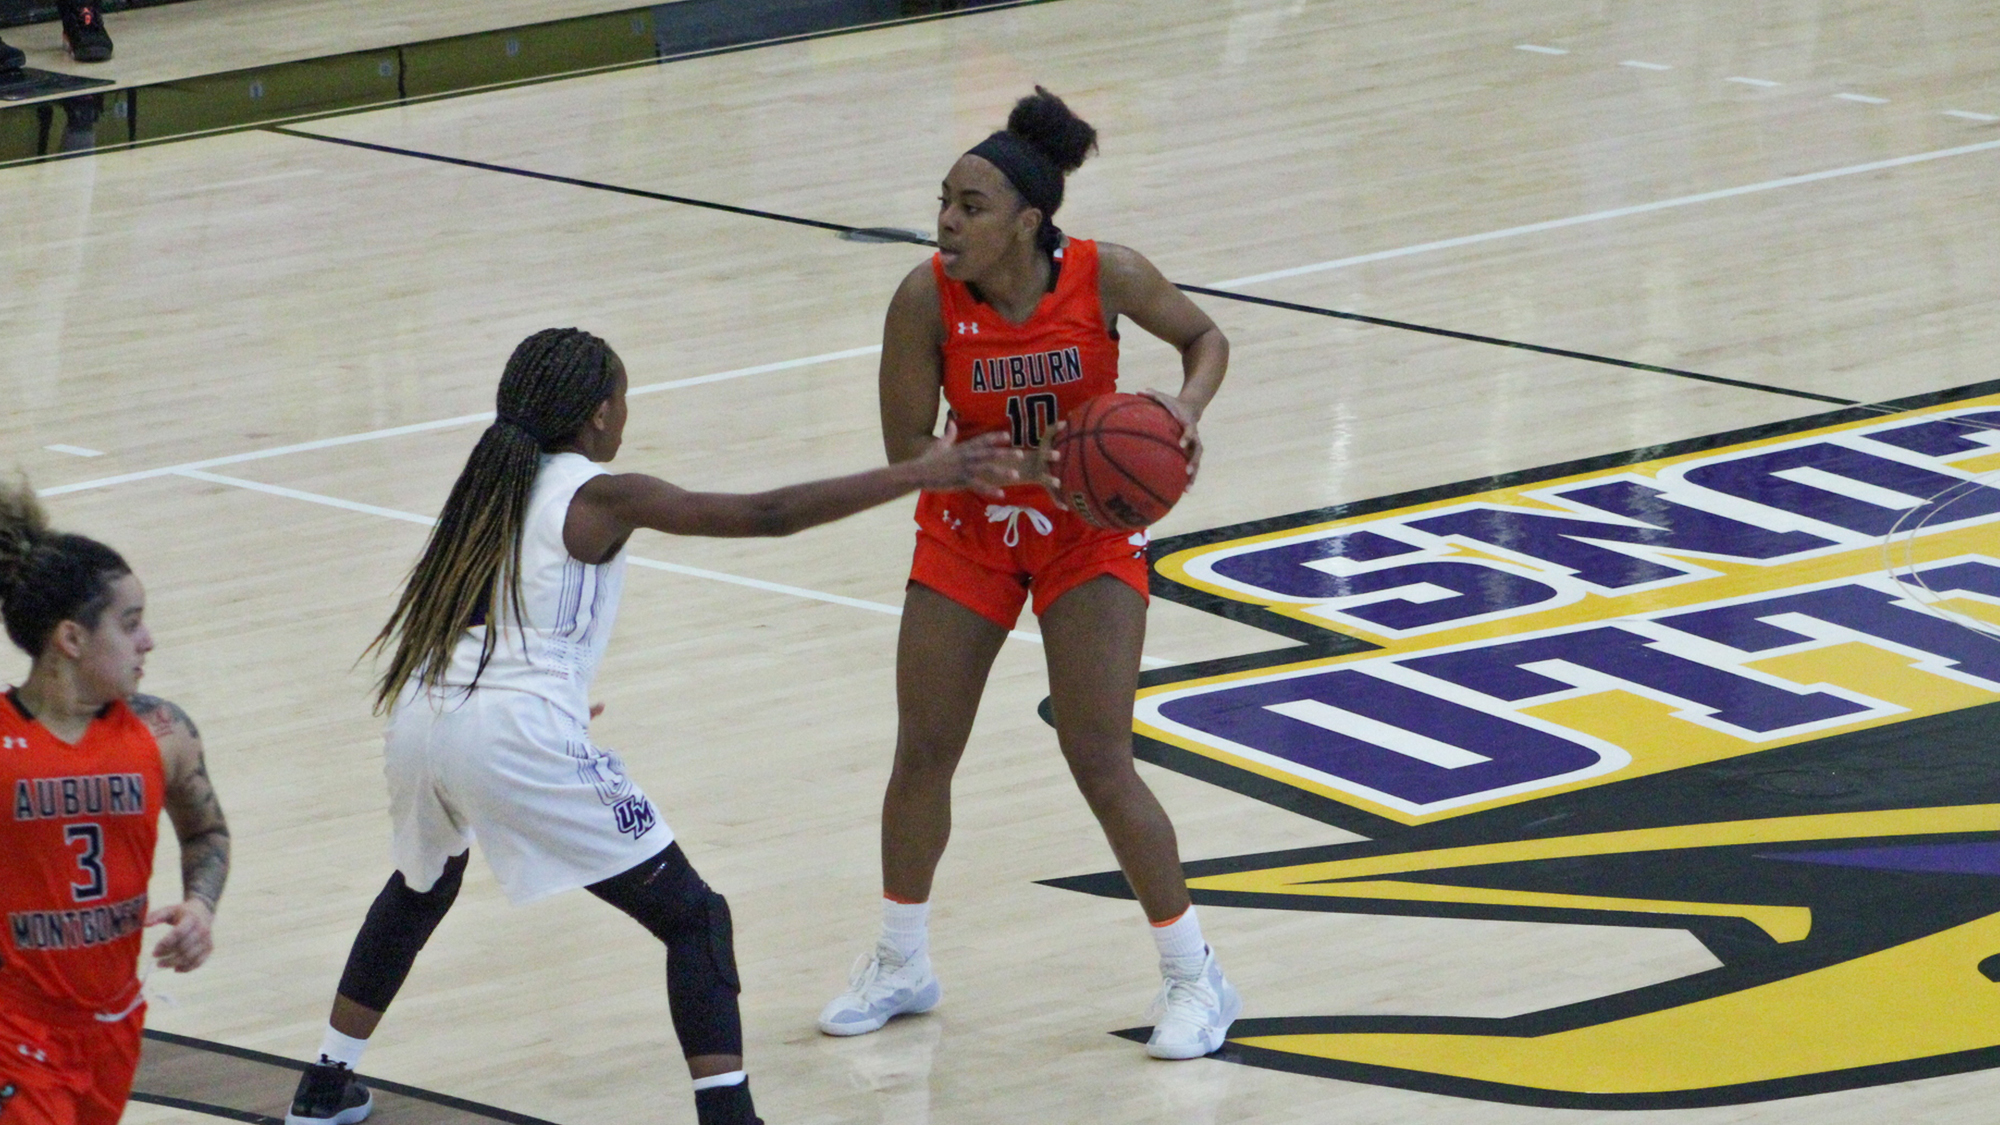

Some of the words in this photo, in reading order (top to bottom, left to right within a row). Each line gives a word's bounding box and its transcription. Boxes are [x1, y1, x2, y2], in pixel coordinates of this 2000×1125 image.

[972, 347, 1083, 393] AUBURN
[1006, 394, 1058, 449] 10
[14, 773, 144, 821] AUBURN
[63, 822, 108, 902] 3
